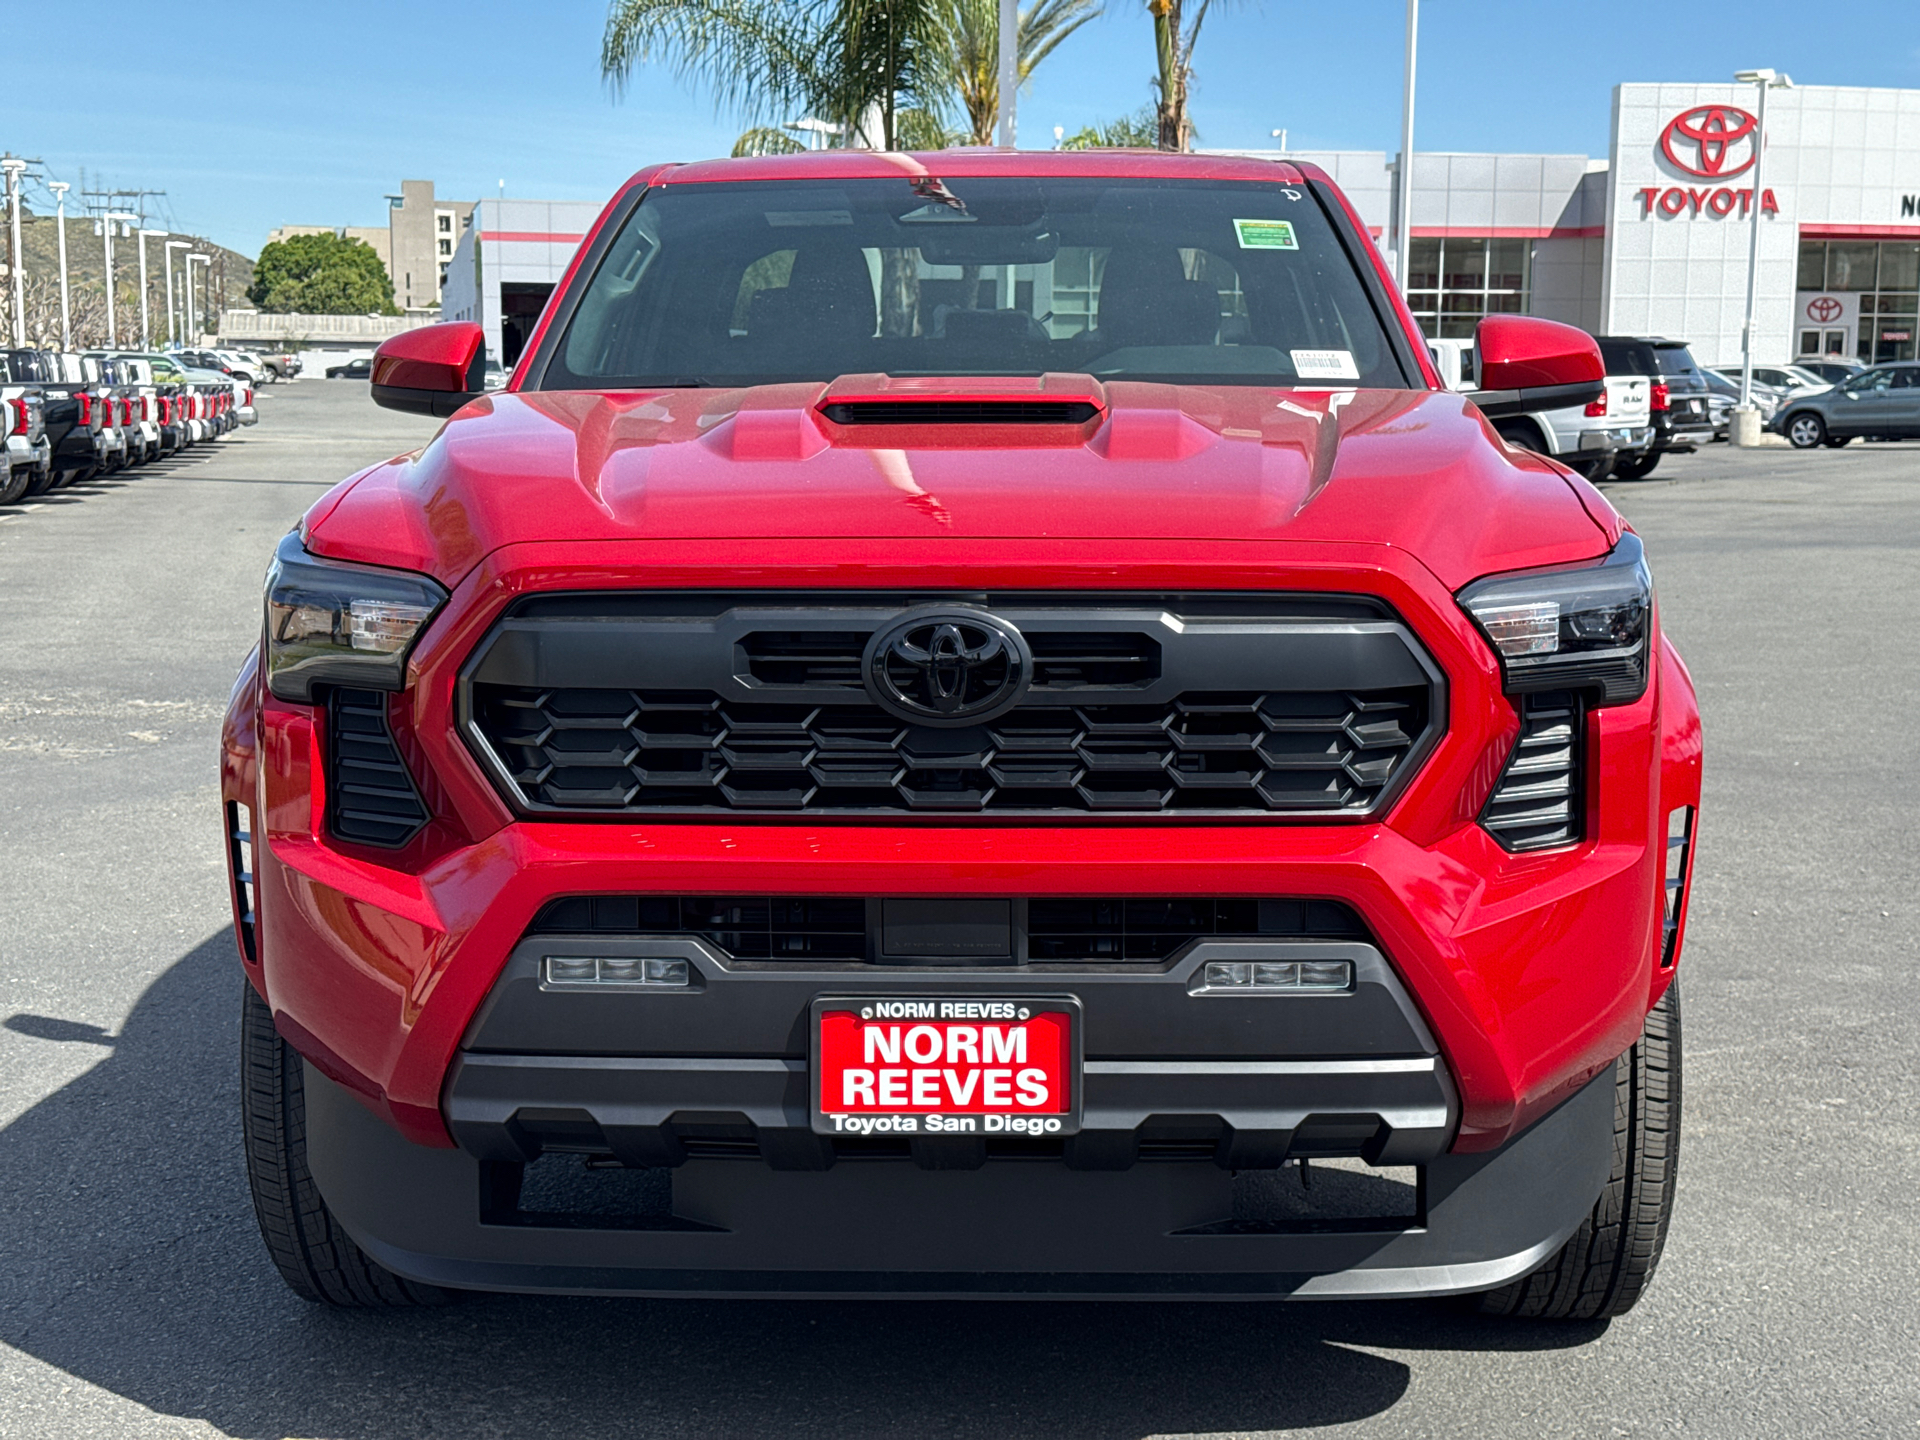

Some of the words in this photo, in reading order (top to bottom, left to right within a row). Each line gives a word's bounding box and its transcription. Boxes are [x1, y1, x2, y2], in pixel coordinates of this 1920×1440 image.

[1640, 187, 1779, 214] TOYOTA
[1901, 194, 1920, 219] N
[1623, 396, 1643, 404] RAM
[876, 1003, 934, 1018] NORM
[941, 1003, 1016, 1018] REEVES
[864, 1026, 1027, 1063] NORM
[842, 1069, 1049, 1106] REEVES
[829, 1114, 918, 1134] Toyota
[925, 1114, 976, 1132] San
[984, 1114, 1062, 1135] Diego
